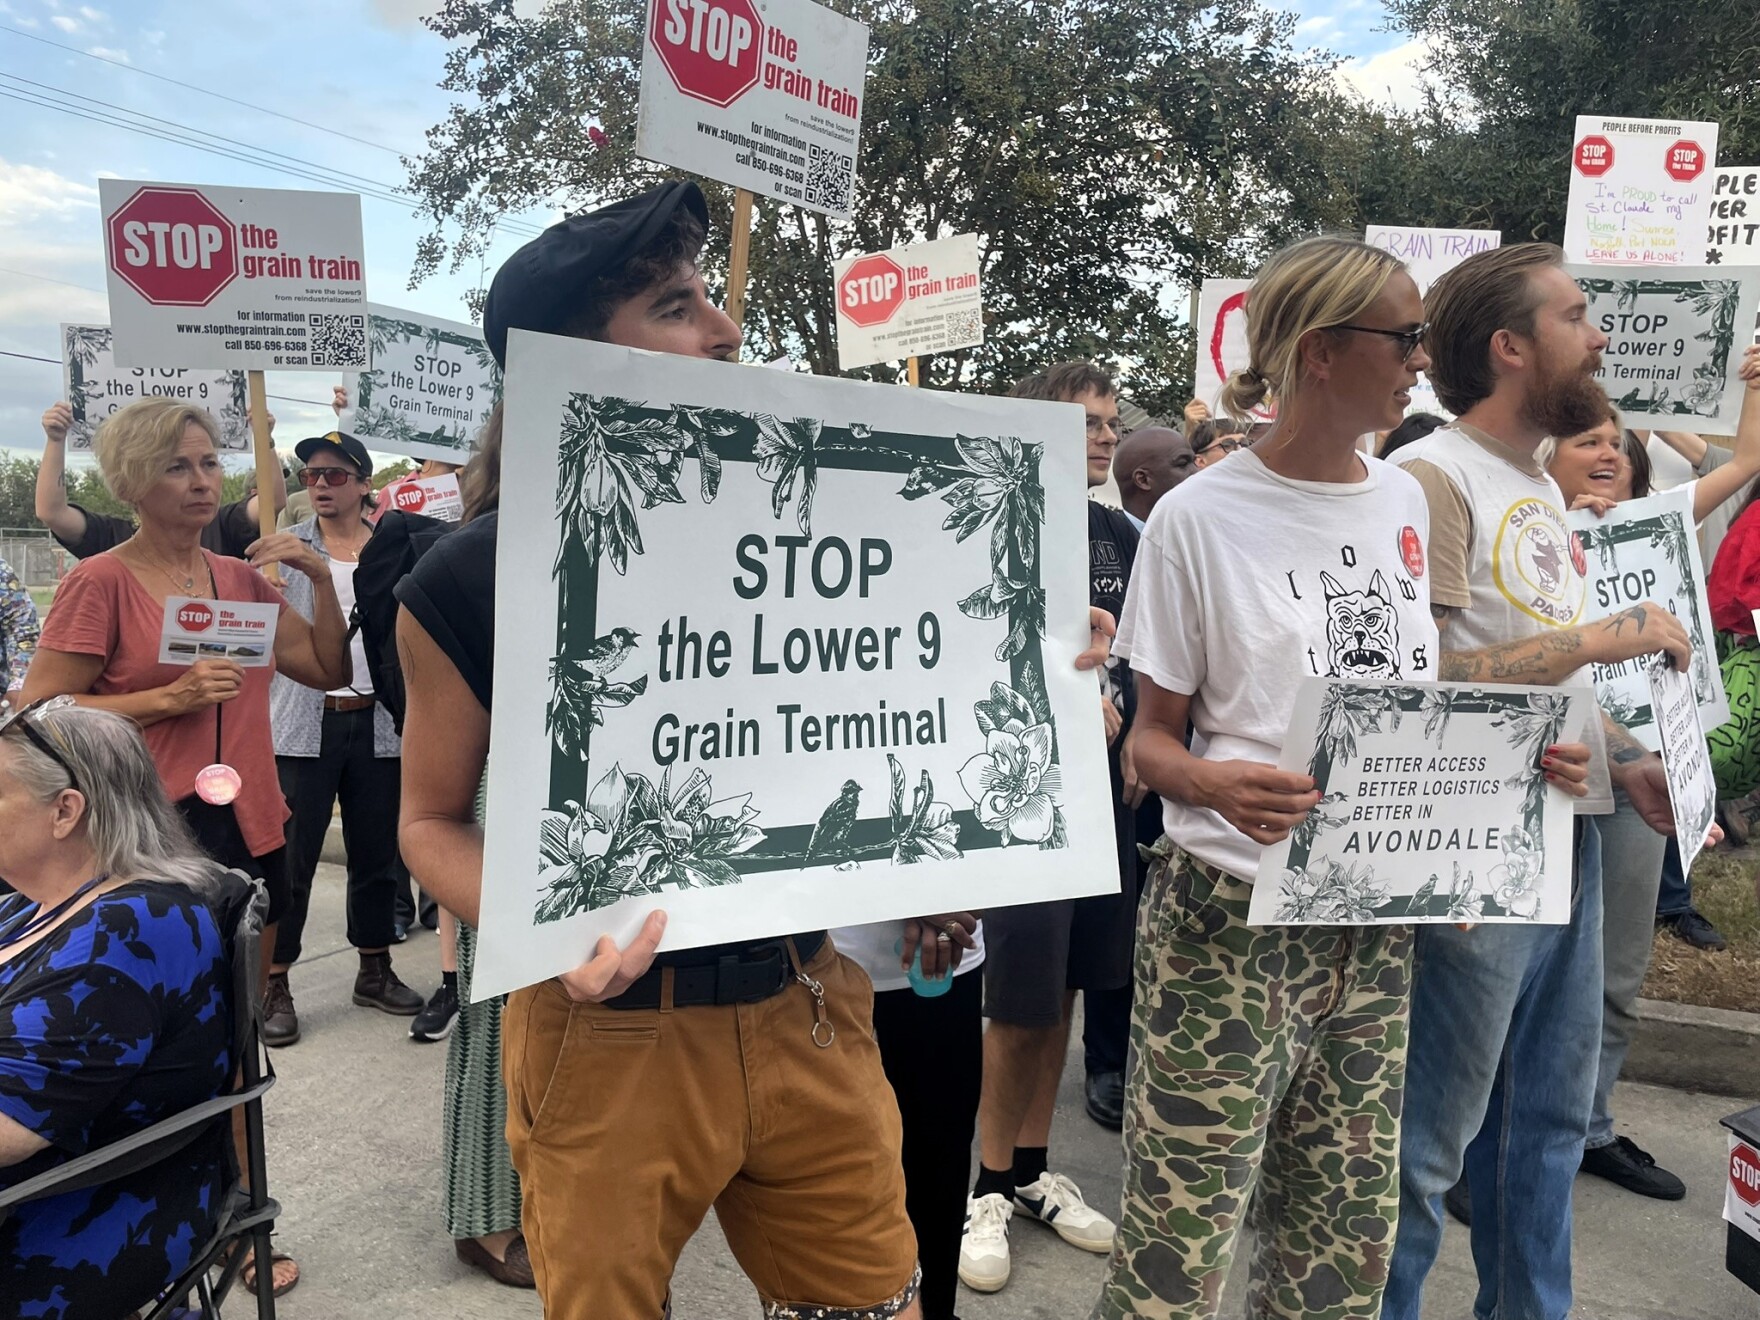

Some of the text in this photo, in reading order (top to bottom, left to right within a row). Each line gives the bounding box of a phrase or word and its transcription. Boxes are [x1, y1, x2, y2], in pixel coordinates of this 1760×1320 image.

[664, 0, 752, 68] STOP
[767, 26, 798, 63] the
[764, 62, 858, 119] grain train
[784, 113, 800, 124] from
[1602, 122, 1681, 135] PEOPLE BEFORE PROFITS
[697, 121, 805, 167] www.stopthegraintrain.com
[751, 121, 807, 151] for information
[1582, 144, 1606, 158] STOP
[1673, 148, 1697, 163] STOP
[735, 152, 804, 184] call 850-696-6368
[774, 181, 802, 199] or scan
[1712, 174, 1757, 195] PLE
[1622, 185, 1656, 203] PROUD
[1660, 192, 1673, 203] to
[1679, 194, 1697, 205] call
[1666, 204, 1682, 220] my
[123, 220, 223, 270] STOP
[240, 223, 279, 250] the
[1585, 249, 1684, 262] LEAVE US ALONE!
[243, 252, 361, 281] grain train
[907, 265, 928, 281] the
[324, 288, 336, 296] the
[845, 271, 898, 308] STOP
[908, 279, 942, 300] grain
[946, 272, 977, 292] train
[274, 294, 293, 302] from
[237, 310, 305, 322] for information
[1599, 313, 1669, 334] STOP
[177, 323, 306, 338] www.stopthegraintrain.com
[225, 340, 307, 351] call 850-696-6368
[1605, 336, 1685, 357] Lower 9
[274, 355, 308, 365] or scan
[414, 354, 462, 379] STOP
[1613, 363, 1681, 380] Terminal
[106, 379, 208, 399] the Lower 9
[391, 371, 474, 402] the Lower 9
[389, 394, 473, 422] Grain Terminal
[397, 490, 422, 507] STOP
[1509, 502, 1540, 528] SAN
[733, 534, 893, 600] STOP
[1595, 568, 1656, 608] STOP
[179, 610, 211, 623] STOP
[219, 610, 235, 619] the
[219, 619, 266, 628] grain train
[658, 611, 941, 683] the Lower 9
[652, 697, 947, 766] Grain Terminal
[1362, 756, 1487, 773] BETTER ACCESS
[1357, 779, 1500, 797] BETTER LOGISTICS
[1352, 804, 1433, 821] BETTER IN
[1342, 827, 1500, 854] AVONDALE
[1732, 1155, 1760, 1192] STOP
